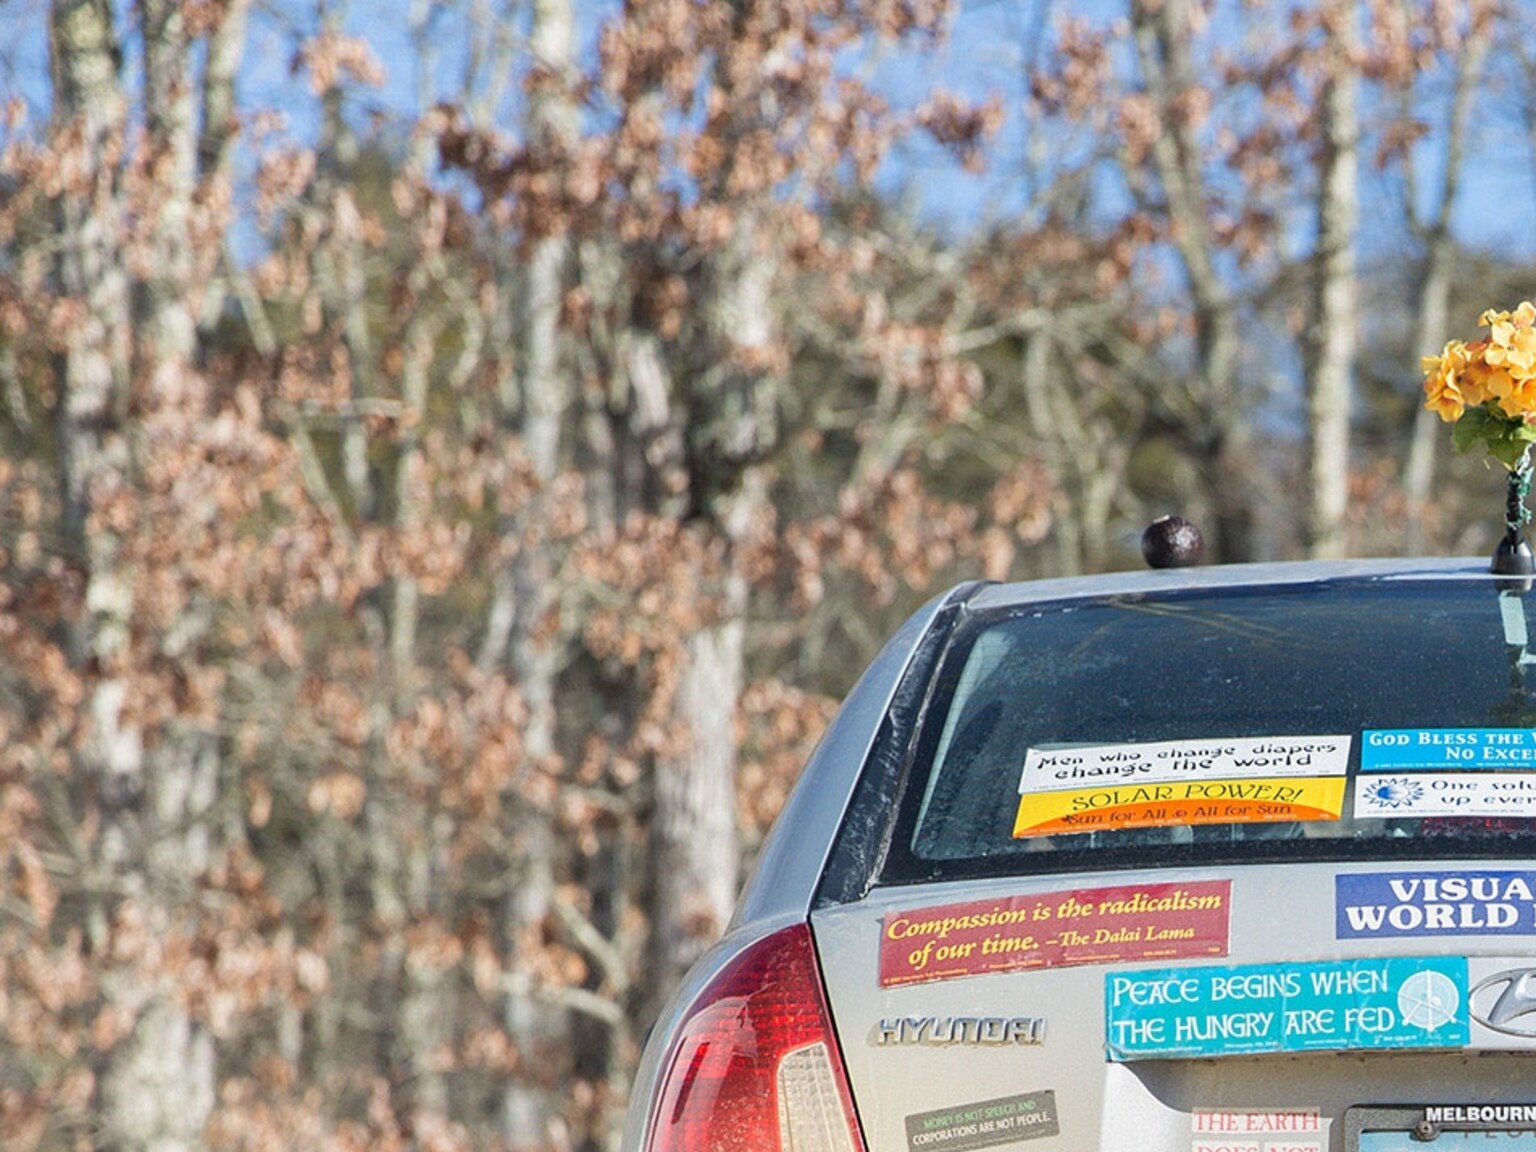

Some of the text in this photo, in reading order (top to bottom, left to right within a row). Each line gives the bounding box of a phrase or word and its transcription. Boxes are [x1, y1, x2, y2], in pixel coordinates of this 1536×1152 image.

[1369, 734, 1410, 745] GOD
[1419, 733, 1478, 745] BLESS
[1487, 734, 1523, 745] THE
[1038, 744, 1337, 769] Men who change diapers
[1445, 747, 1473, 759] NO
[1055, 755, 1311, 779] change the world
[1073, 787, 1175, 811] SOLAR
[1186, 784, 1303, 801] POWER!
[888, 893, 1222, 939] Compassion is the radicalism
[1345, 904, 1519, 931] WORLD
[908, 944, 936, 969] of
[936, 944, 976, 960] our
[982, 933, 1040, 958] time.
[1095, 927, 1141, 943] Dalai
[1144, 926, 1195, 940] Lama
[1113, 970, 1388, 1006] PEACE BEGINS WHEN
[878, 1018, 1046, 1046] HYUNDAI
[1113, 1019, 1165, 1043] THE
[1176, 1012, 1274, 1040] HUNGRY
[1284, 1011, 1335, 1035] ARE
[1344, 1007, 1395, 1032] FED
[1197, 1112, 1318, 1131] THE EARTH
